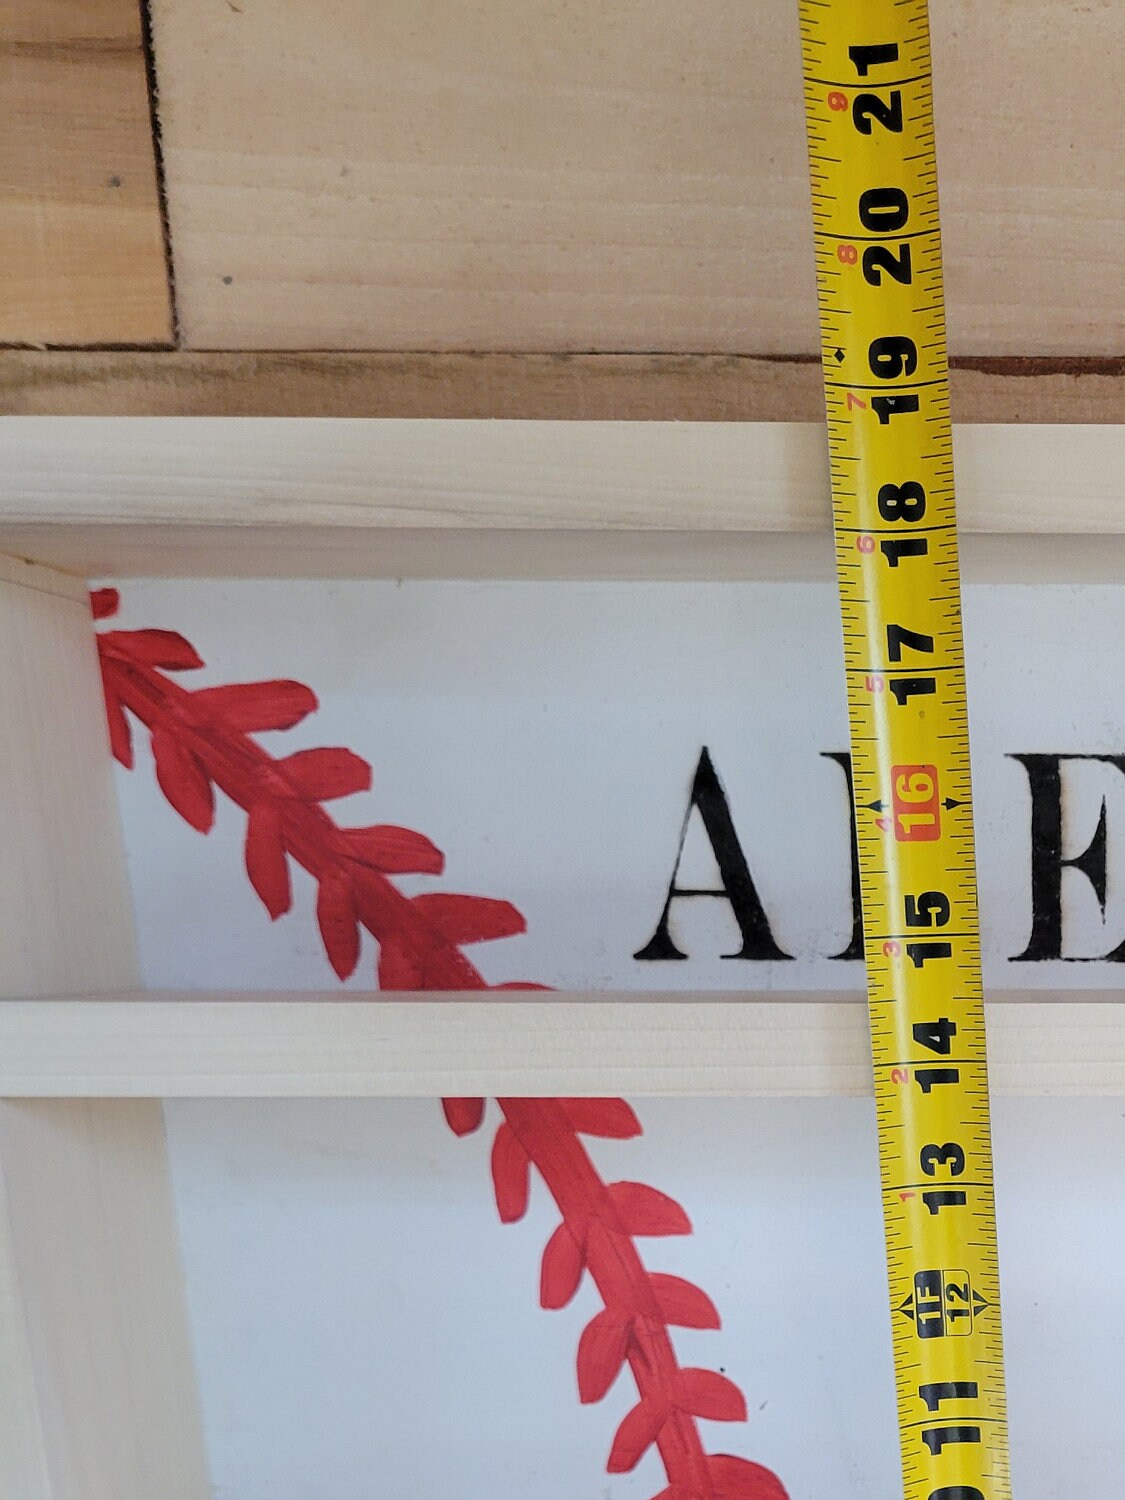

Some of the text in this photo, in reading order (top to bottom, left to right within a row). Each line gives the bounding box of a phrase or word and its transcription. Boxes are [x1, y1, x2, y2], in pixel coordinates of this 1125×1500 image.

[828, 91, 848, 112] 9
[848, 43, 903, 135] 21
[837, 244, 858, 265] 8
[858, 187, 912, 287] 20
[847, 392, 867, 411] 7
[868, 336, 920, 424] 19
[856, 535, 876, 554] 6
[877, 481, 928, 567] 18
[865, 676, 884, 694] 5
[887, 624, 937, 706] 17
[895, 772, 936, 835] 16
[882, 941, 901, 958] 3
[904, 891, 952, 968] 15
[890, 1068, 909, 1085] 2
[912, 1018, 960, 1094] 14
[899, 1192, 916, 1203] 1
[920, 1142, 967, 1215] 13
[916, 1286, 941, 1325] 1F
[946, 1283, 970, 1322] 12
[919, 1381, 981, 1456] 11
